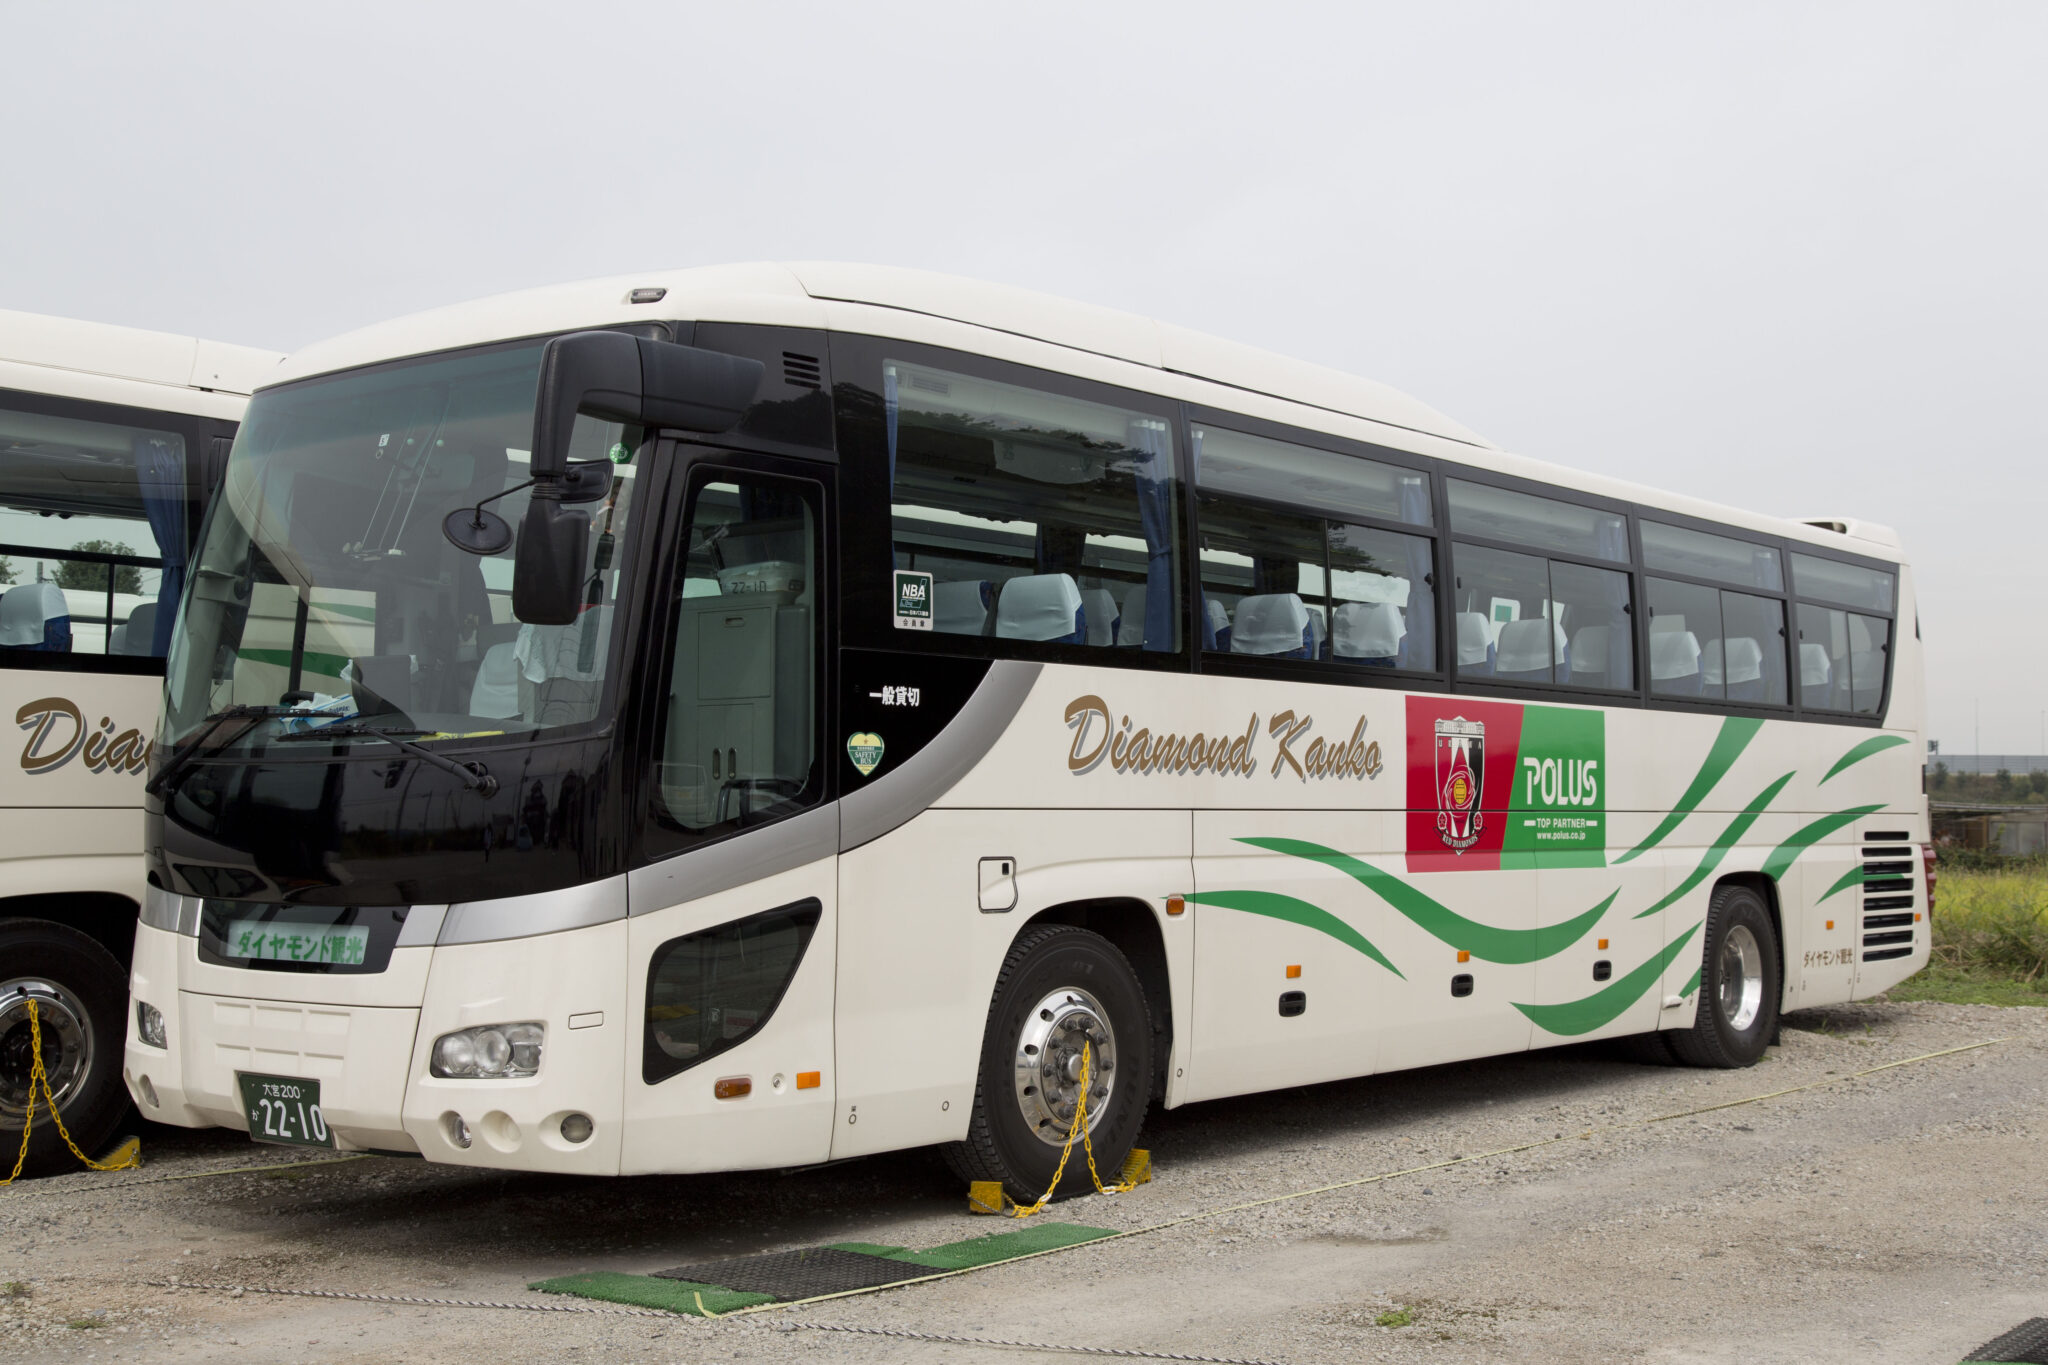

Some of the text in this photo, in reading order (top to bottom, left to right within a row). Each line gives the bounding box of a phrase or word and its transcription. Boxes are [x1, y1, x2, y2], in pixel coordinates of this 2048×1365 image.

[902, 583, 926, 598] NBA
[869, 685, 920, 706] 一般貸切
[16, 696, 153, 776] Dia
[1064, 694, 1383, 784] Diamond Kanko
[1523, 756, 1598, 806] POLUS
[1536, 831, 1586, 841] www.polus.co.jp
[1537, 817, 1586, 829] TOP PARTNER
[238, 930, 363, 964] ダイヤモンド観光
[259, 1098, 327, 1142] 22-10
